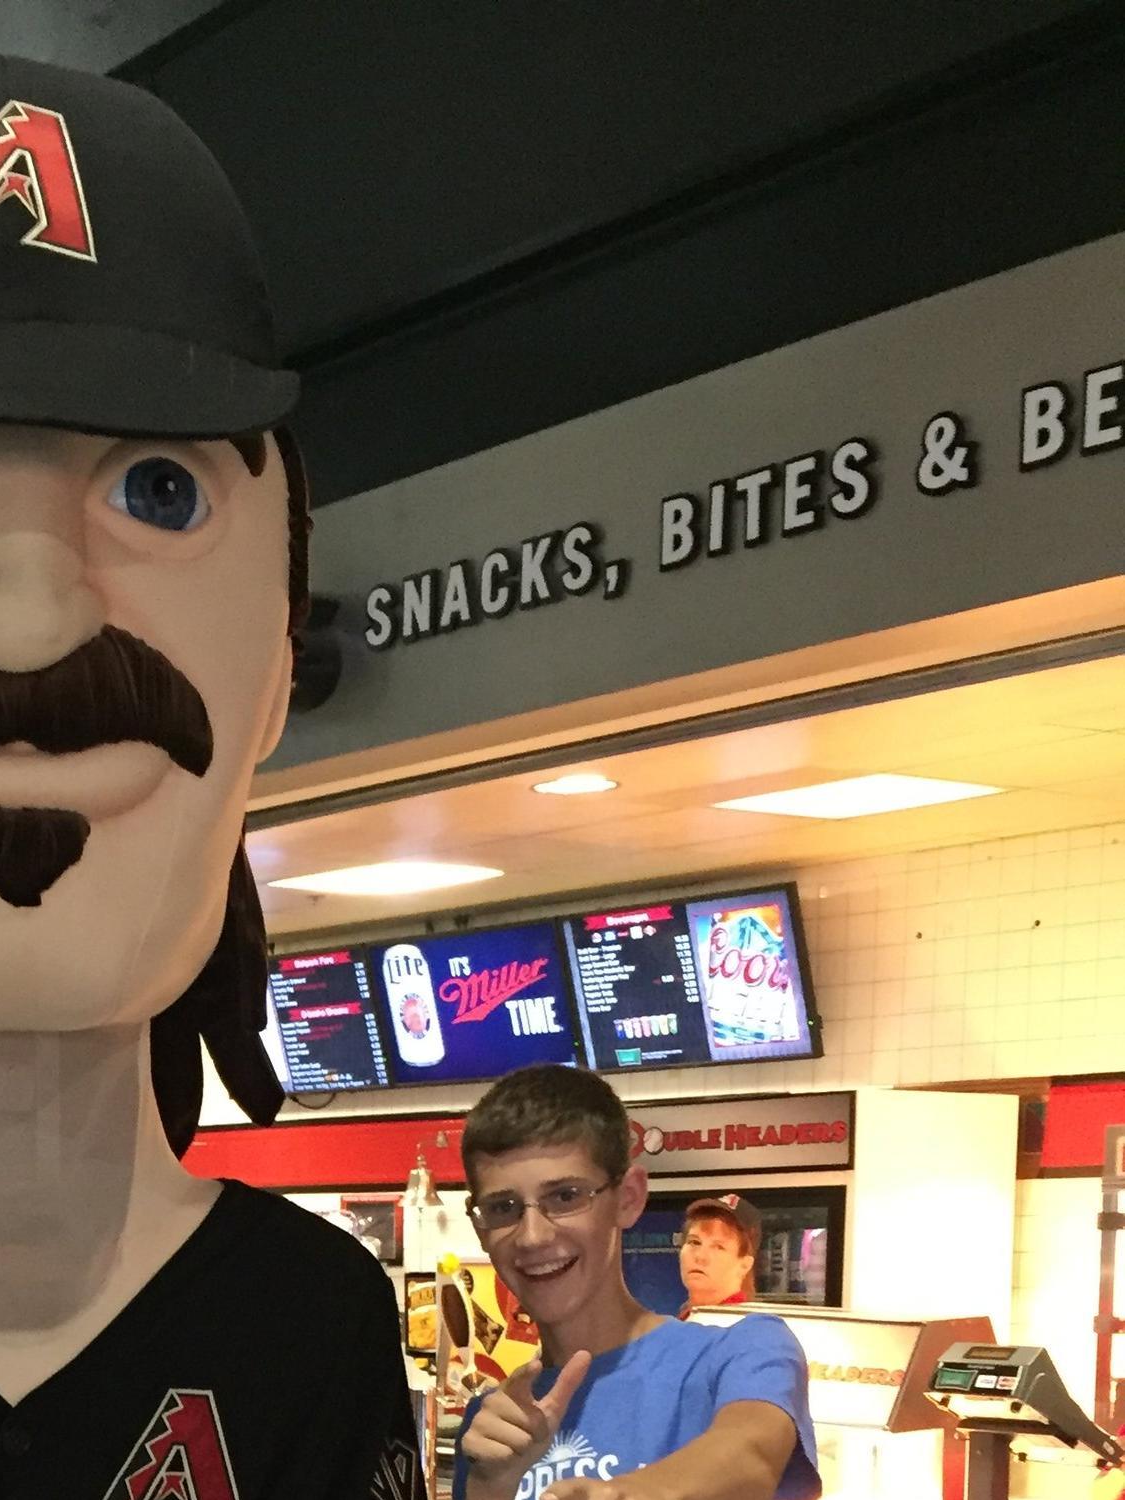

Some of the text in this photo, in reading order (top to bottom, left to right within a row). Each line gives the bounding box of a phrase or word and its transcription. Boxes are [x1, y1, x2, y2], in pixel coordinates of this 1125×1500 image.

[365, 366, 1125, 648] SNACKS, BITES & BE
[387, 955, 424, 984] Lite
[439, 956, 550, 1025] Miller
[724, 1121, 848, 1151] HEADERS
